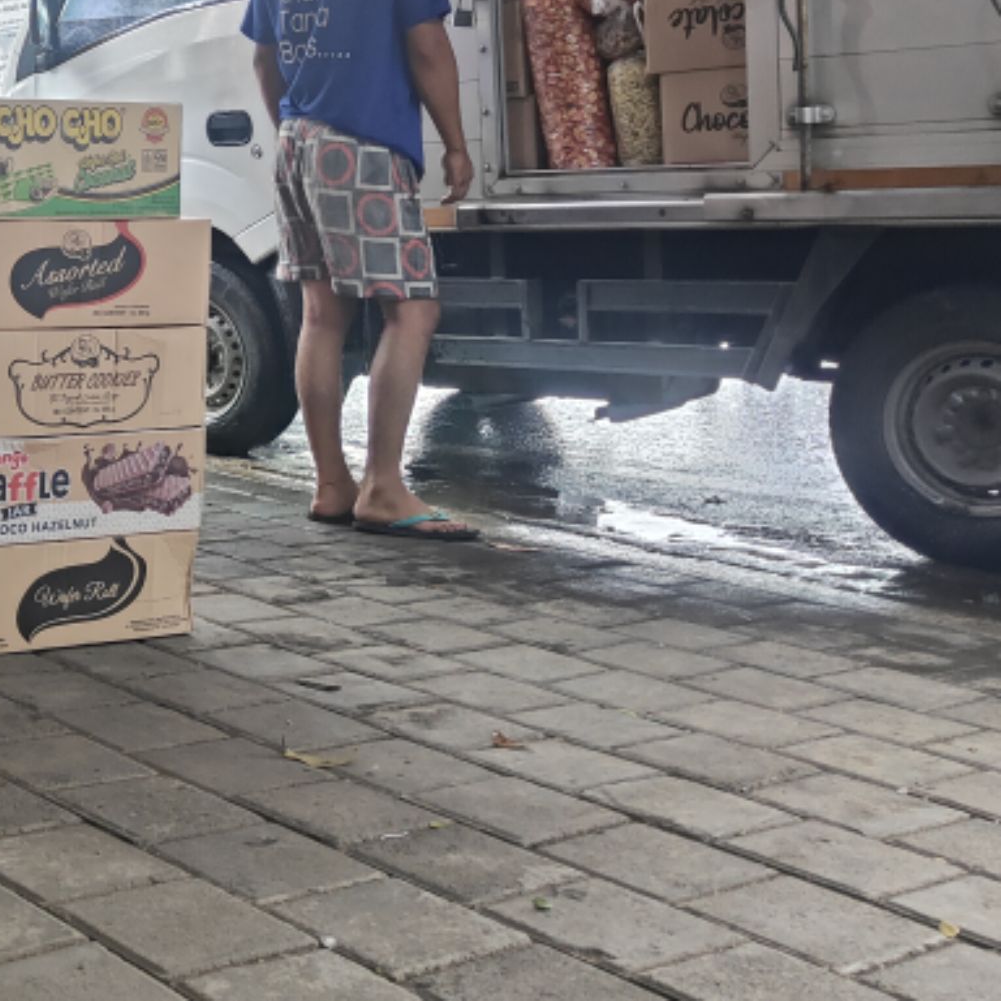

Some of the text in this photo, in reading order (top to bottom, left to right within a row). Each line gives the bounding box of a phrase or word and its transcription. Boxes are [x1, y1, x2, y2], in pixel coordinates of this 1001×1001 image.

[61, 106, 123, 151] CHO
[20, 245, 127, 291] Assorted
[31, 372, 86, 391] BUTTER
[31, 516, 97, 533] HAZELNUT
